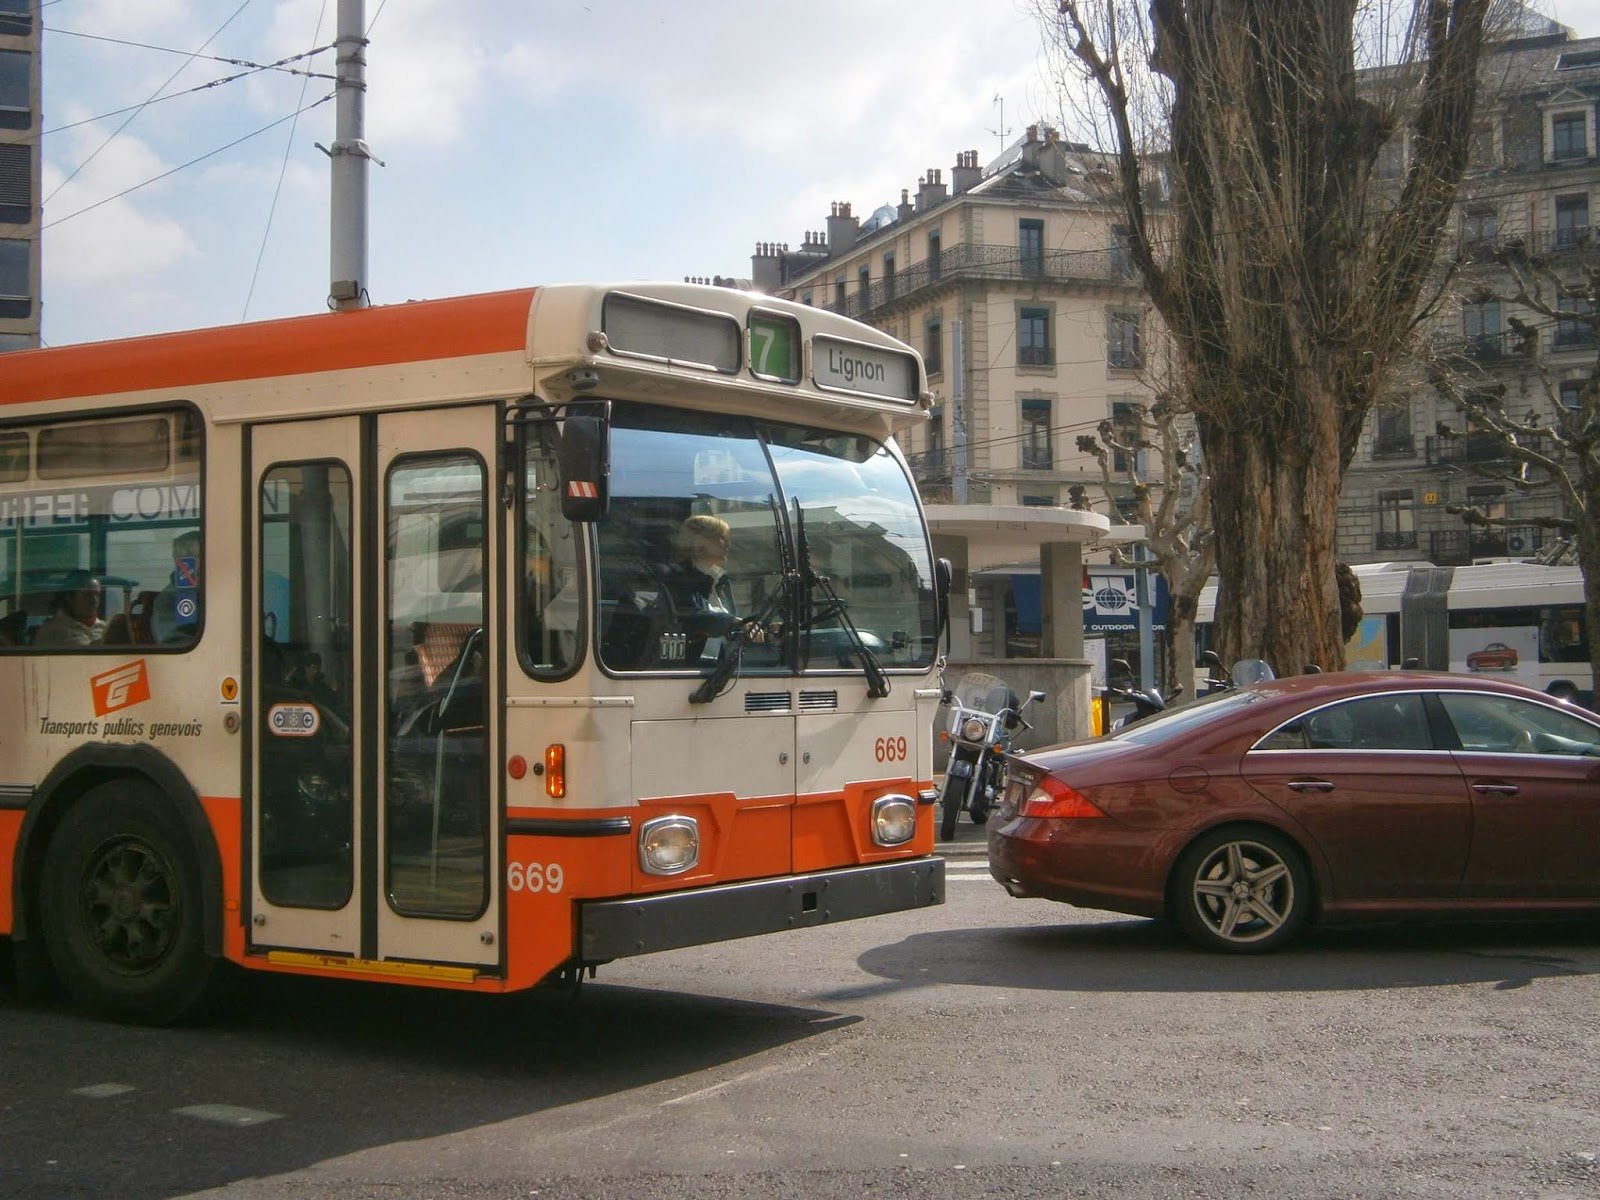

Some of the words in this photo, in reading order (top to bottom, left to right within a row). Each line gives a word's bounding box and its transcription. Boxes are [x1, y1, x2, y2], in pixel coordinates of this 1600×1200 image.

[754, 326, 775, 374] 7
[828, 348, 886, 382] Lignon
[39, 717, 98, 738] Transports
[102, 718, 144, 738] publics
[149, 718, 202, 740] genevois
[875, 735, 907, 763] 669
[507, 861, 563, 894] 669
